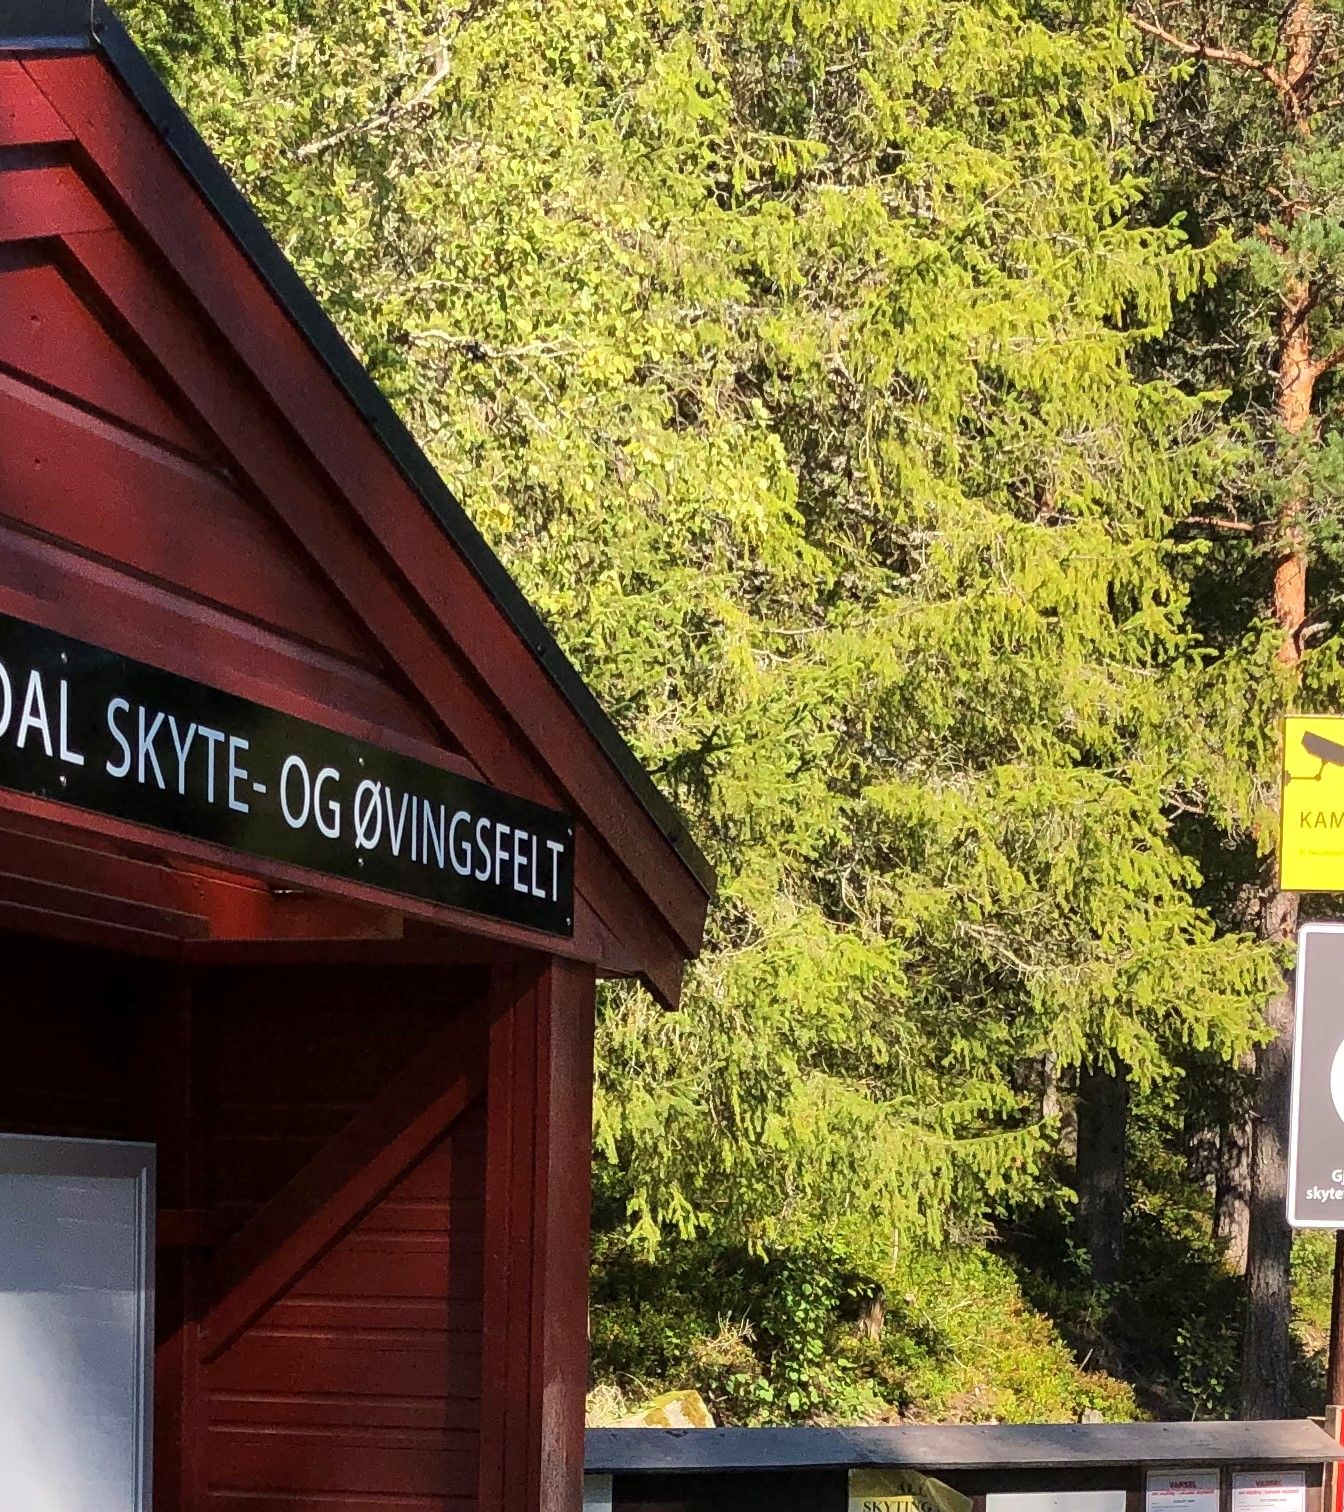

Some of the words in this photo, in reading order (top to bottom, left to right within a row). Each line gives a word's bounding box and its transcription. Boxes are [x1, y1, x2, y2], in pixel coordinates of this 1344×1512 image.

[104, 696, 267, 814] SKYTE-
[280, 753, 342, 839] OG
[354, 776, 566, 903] ØVINGSFELT
